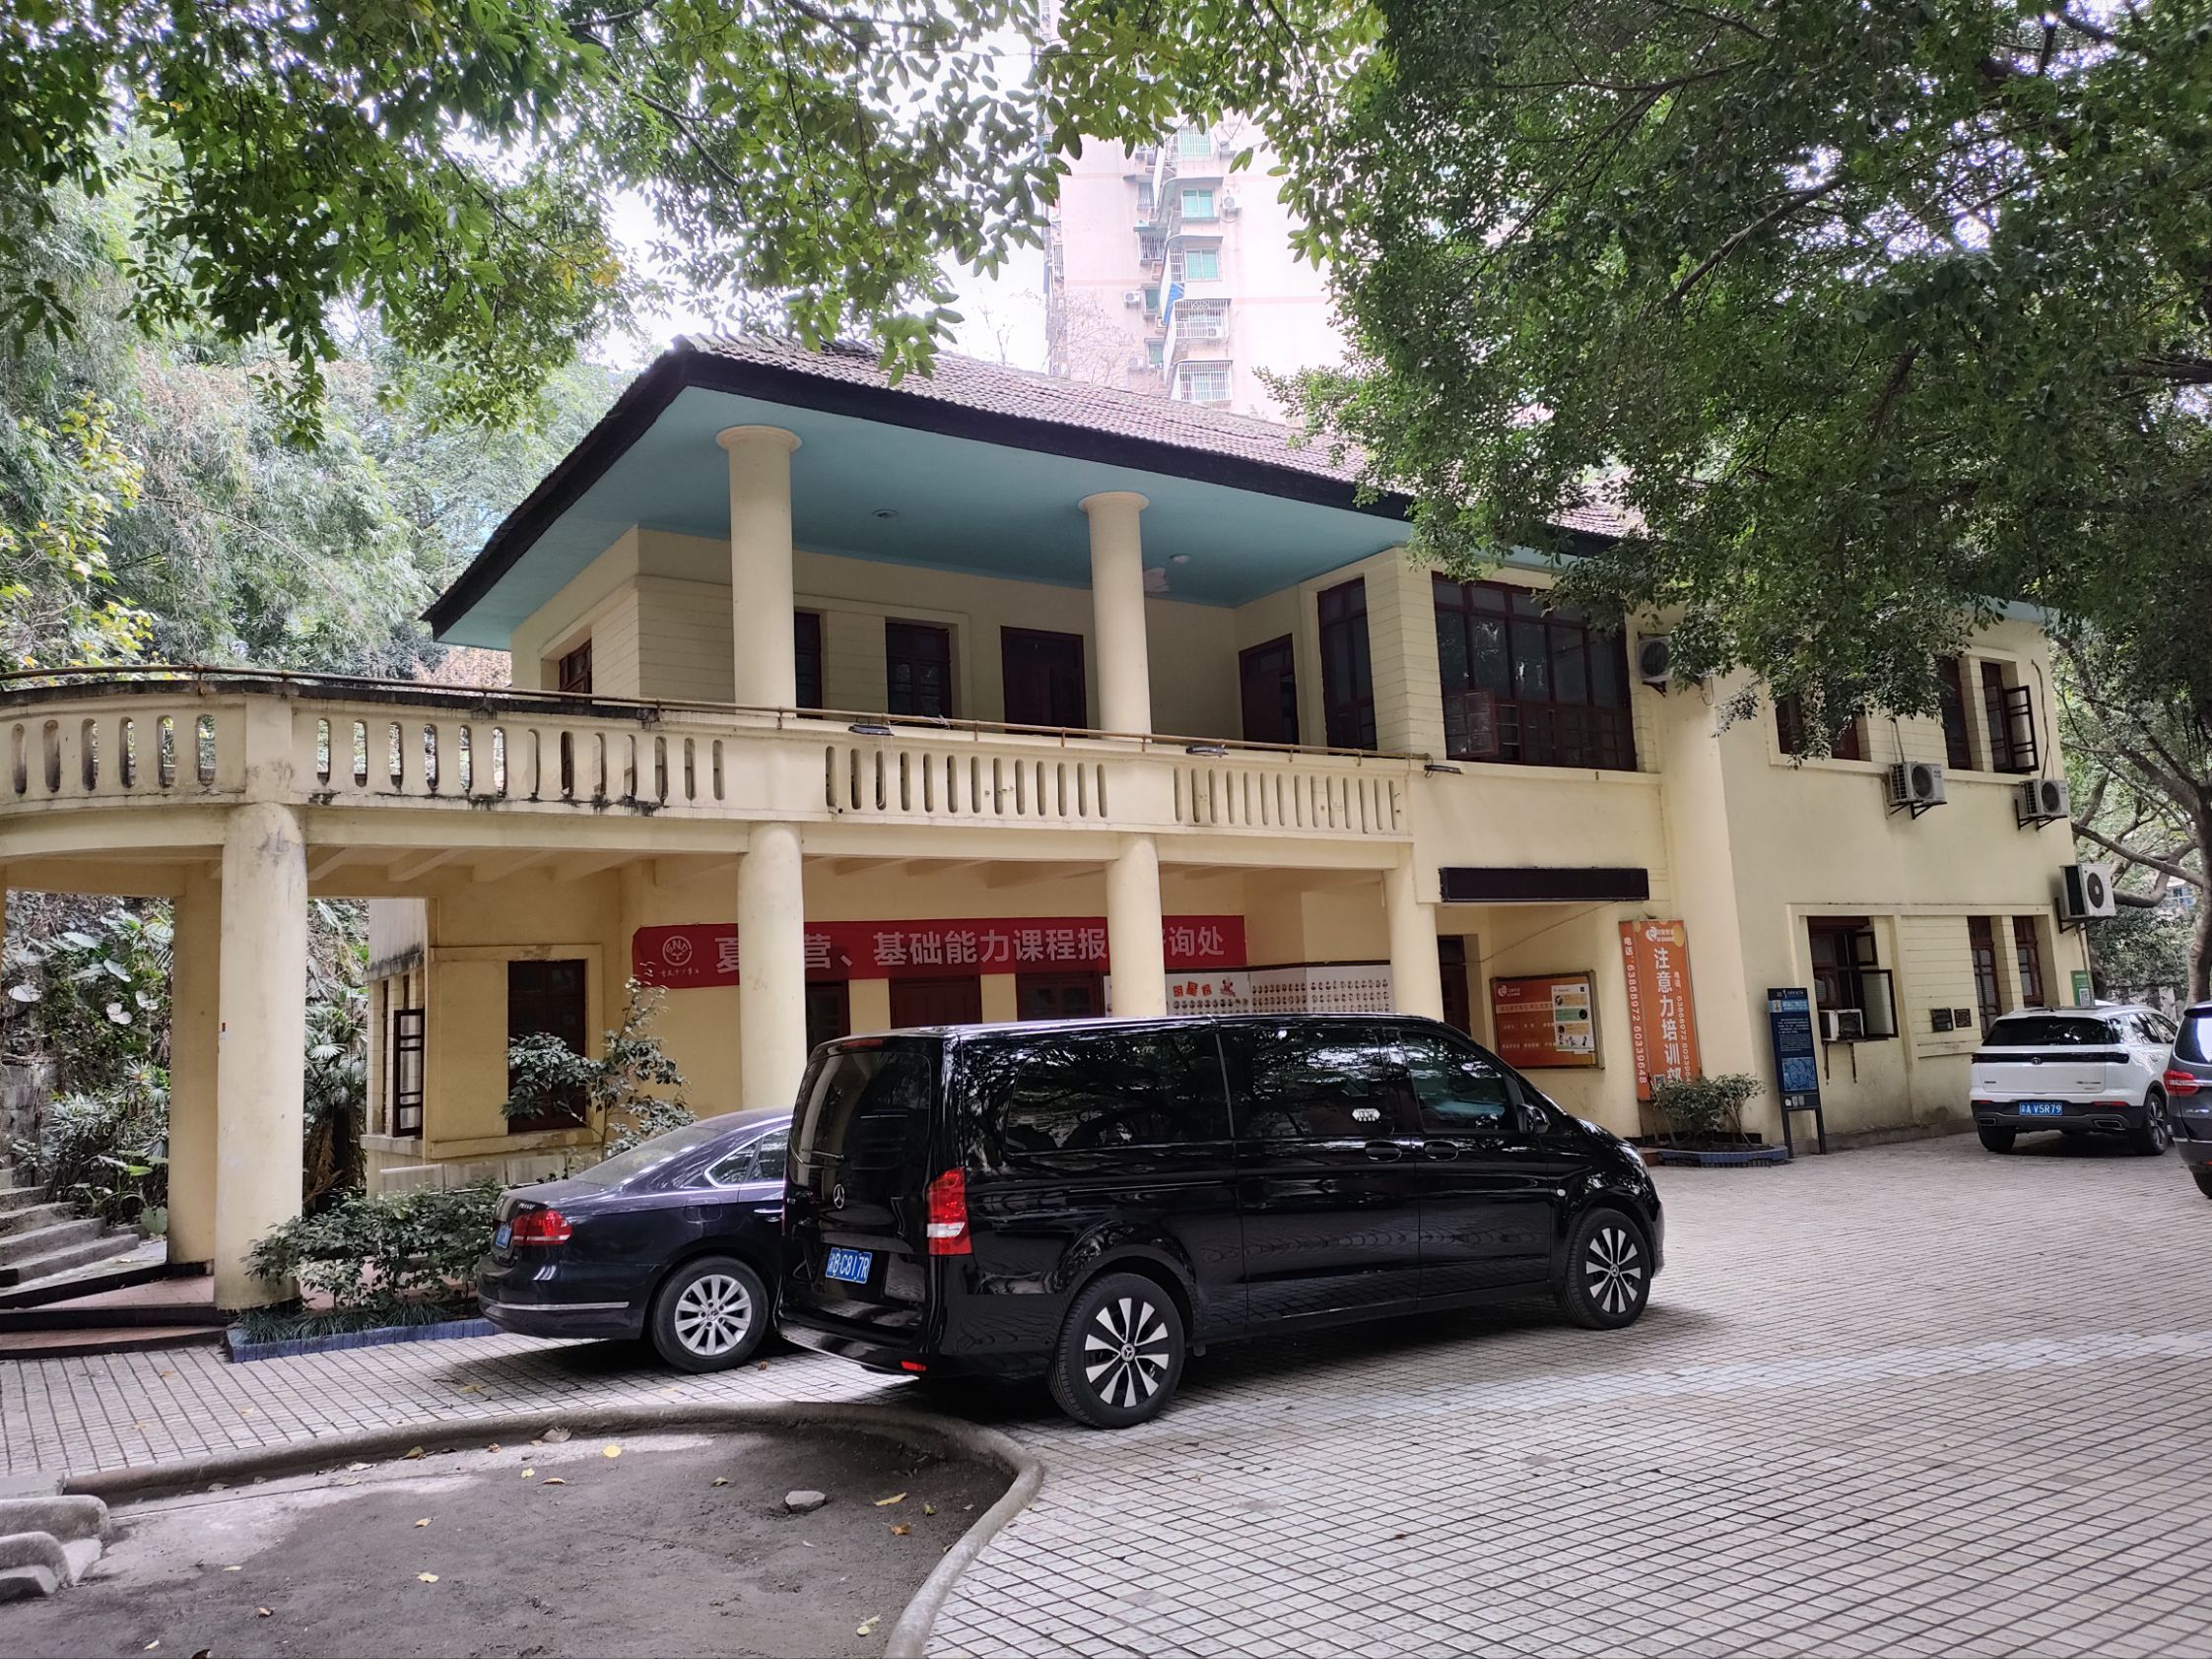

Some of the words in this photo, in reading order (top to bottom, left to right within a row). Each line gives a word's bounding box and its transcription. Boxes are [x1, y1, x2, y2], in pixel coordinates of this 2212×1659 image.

[714, 926, 1225, 974] 夏营、基础能力课程报询处
[1681, 1043, 1692, 1086] 6033964
